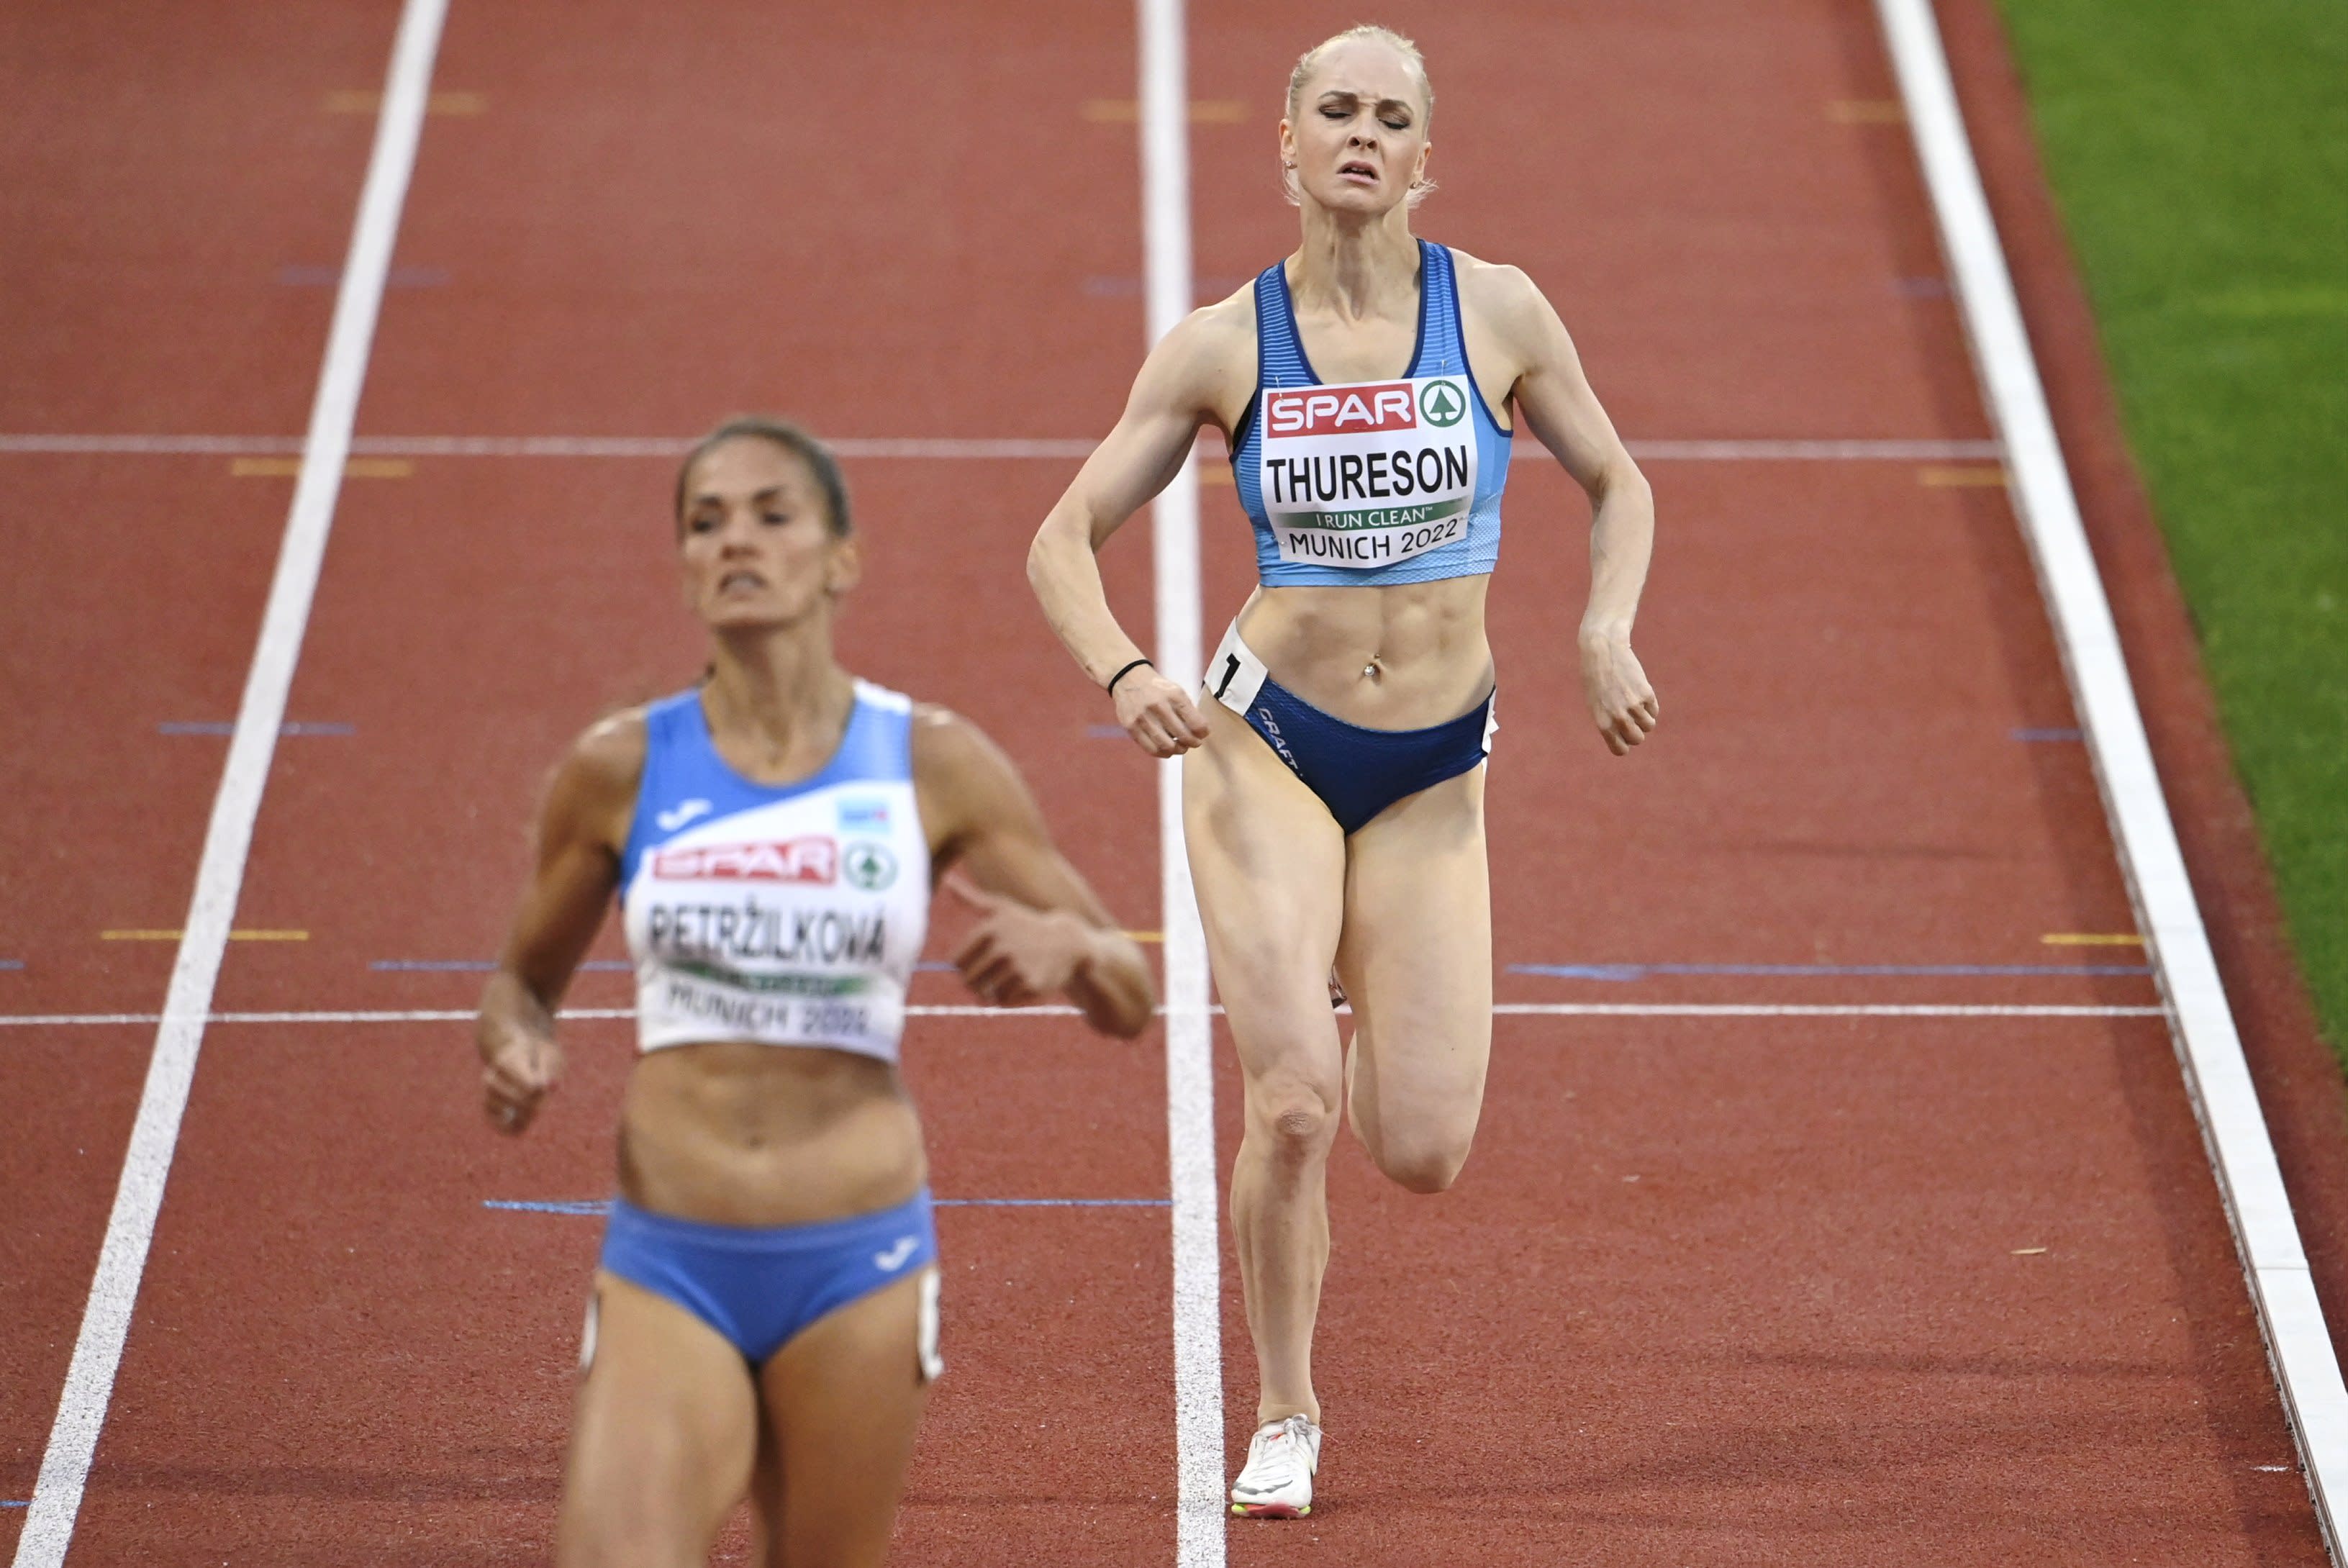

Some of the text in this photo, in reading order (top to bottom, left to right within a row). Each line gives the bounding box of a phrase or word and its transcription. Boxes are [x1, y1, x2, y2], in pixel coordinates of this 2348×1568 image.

[1272, 391, 1411, 432] SPAR
[1266, 445, 1468, 503] THURESON
[1289, 519, 1458, 560] MUNICH 2022
[1316, 514, 1321, 527] I
[1325, 510, 1362, 529] RUN
[1214, 653, 1241, 699] 1
[1258, 707, 1300, 770] CRAFT
[661, 842, 833, 883] SPAR
